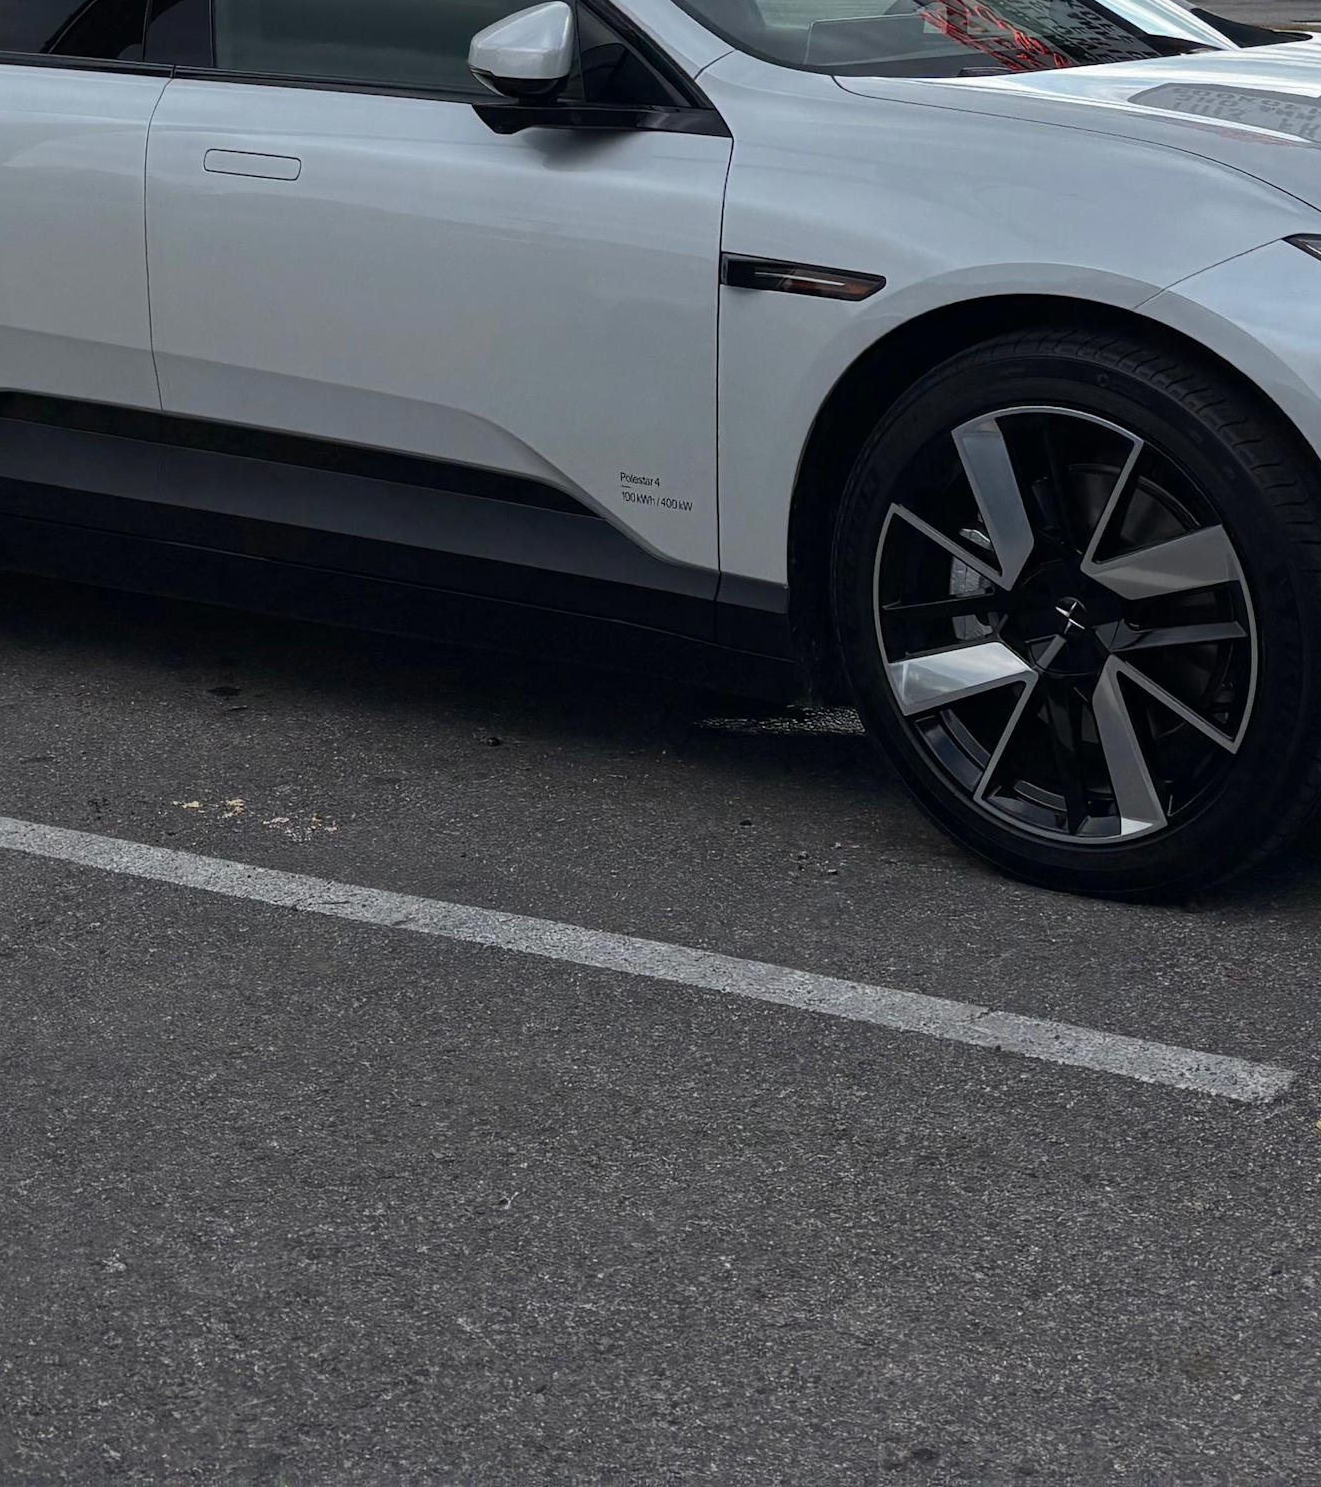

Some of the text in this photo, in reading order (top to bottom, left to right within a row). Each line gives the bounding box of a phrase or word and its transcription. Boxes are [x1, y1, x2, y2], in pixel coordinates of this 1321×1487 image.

[620, 472, 660, 487] Polestar 4
[621, 491, 636, 502] 100
[661, 498, 678, 510] 400
